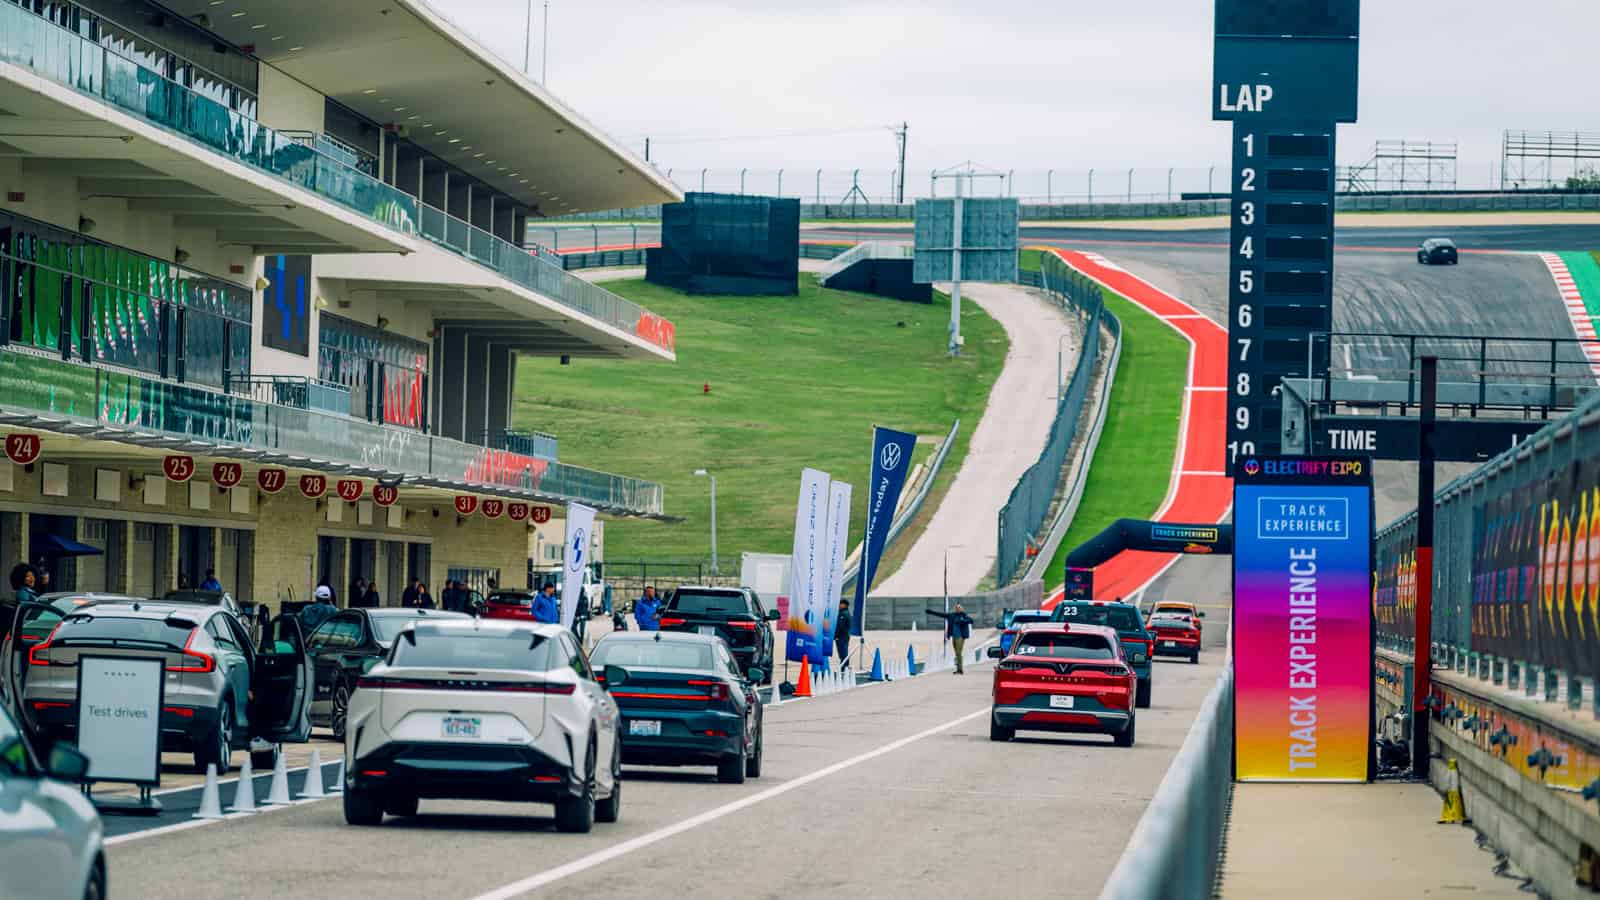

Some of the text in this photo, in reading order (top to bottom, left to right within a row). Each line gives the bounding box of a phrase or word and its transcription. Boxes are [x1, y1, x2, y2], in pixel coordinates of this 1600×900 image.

[1220, 84, 1273, 112] LAP
[1242, 133, 1253, 157] 1
[1241, 167, 1256, 191] 2
[1240, 201, 1254, 225] 3
[1239, 236, 1253, 259] 4
[1239, 270, 1253, 293] 5
[1238, 304, 1252, 328] 6
[1237, 338, 1251, 361] 7
[1236, 372, 1250, 396] 8
[1236, 406, 1250, 430] 9
[14, 438, 33, 457] 24
[1327, 429, 1377, 450] TIME
[171, 459, 188, 476] 25
[219, 465, 236, 481] 26
[1264, 461, 1362, 475] ELECTRIFY EXPO
[264, 471, 280, 487] 27
[305, 478, 321, 493] 28
[342, 482, 358, 497] 29
[378, 487, 393, 502] 30
[874, 477, 889, 513] today
[459, 496, 472, 511] 31
[486, 501, 500, 514] 32
[511, 505, 525, 518] 33
[1280, 504, 1326, 516] TRACK
[534, 508, 548, 521] 34
[1265, 519, 1341, 532] EXPERIENCE
[1176, 529, 1214, 539] EXPERIENCE
[1063, 606, 1079, 616] 23
[1288, 548, 1318, 772] TRACK EXPERIENCE
[88, 704, 149, 719] Test drives
